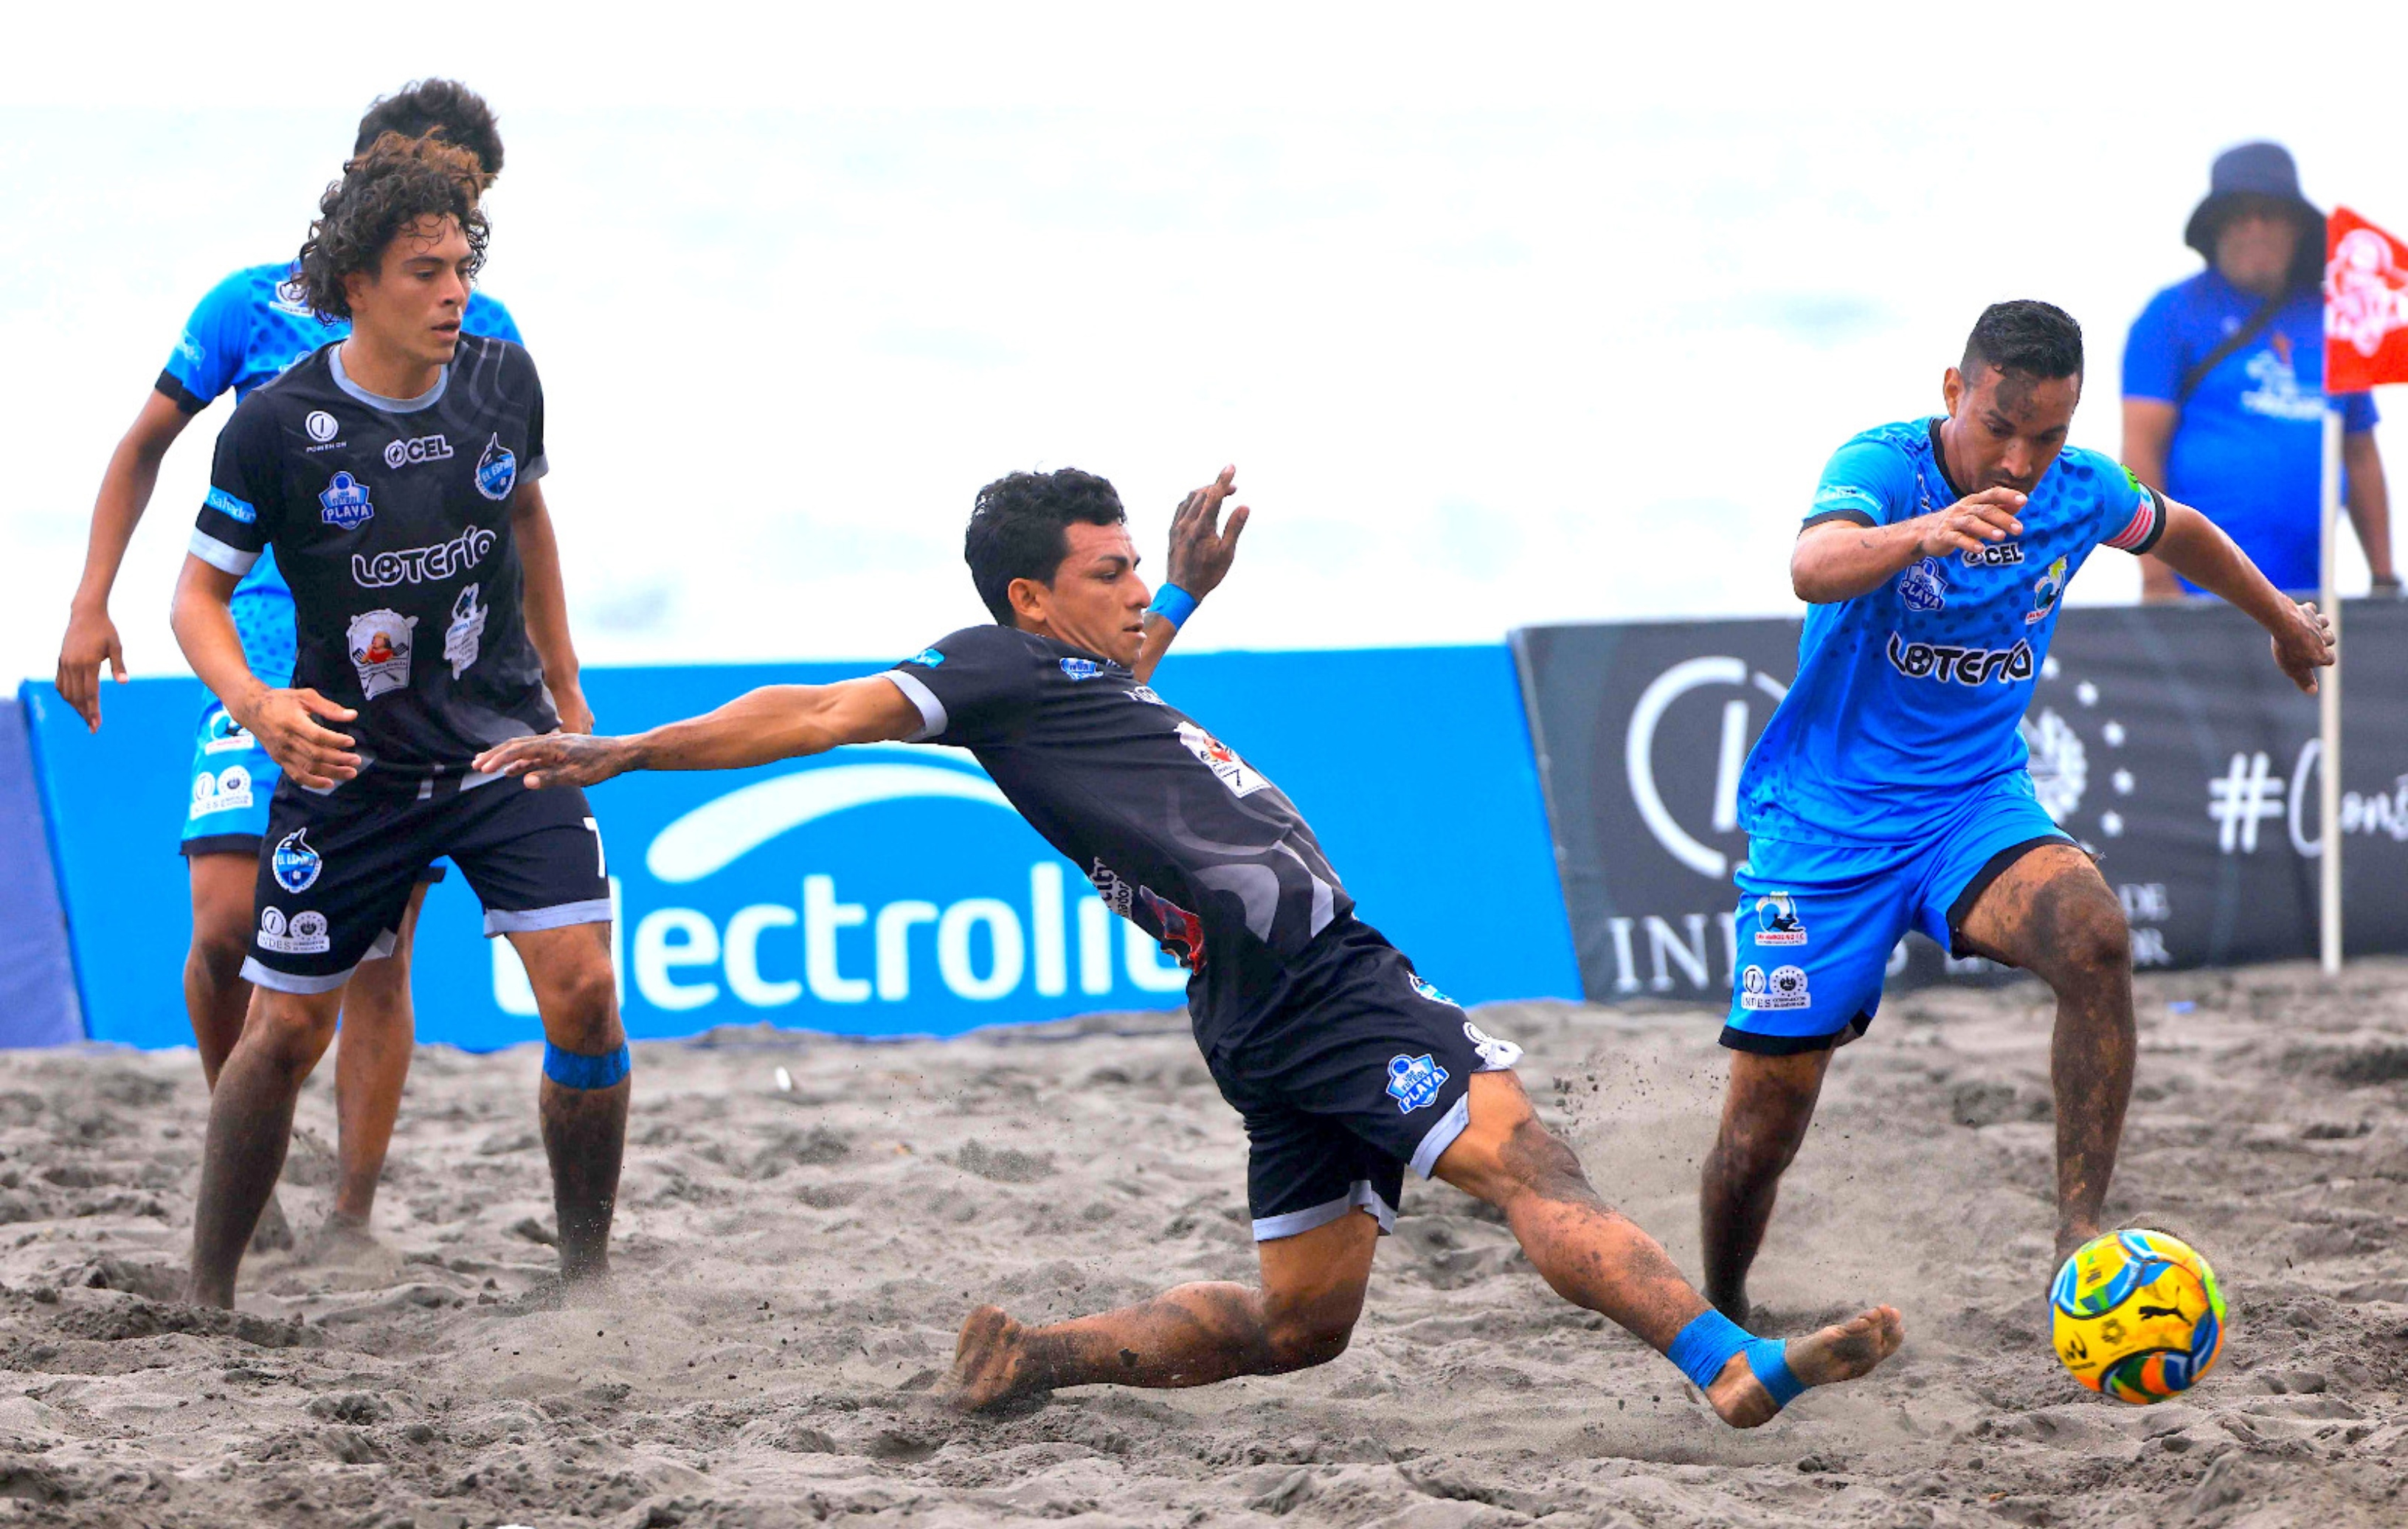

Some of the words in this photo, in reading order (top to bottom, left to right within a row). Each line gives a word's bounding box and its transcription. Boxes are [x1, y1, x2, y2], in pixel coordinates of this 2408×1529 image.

[326, 504, 370, 522] PLAYA
[1900, 580, 1940, 608] PLAYA
[1402, 1071, 1445, 1110] PLAYA
